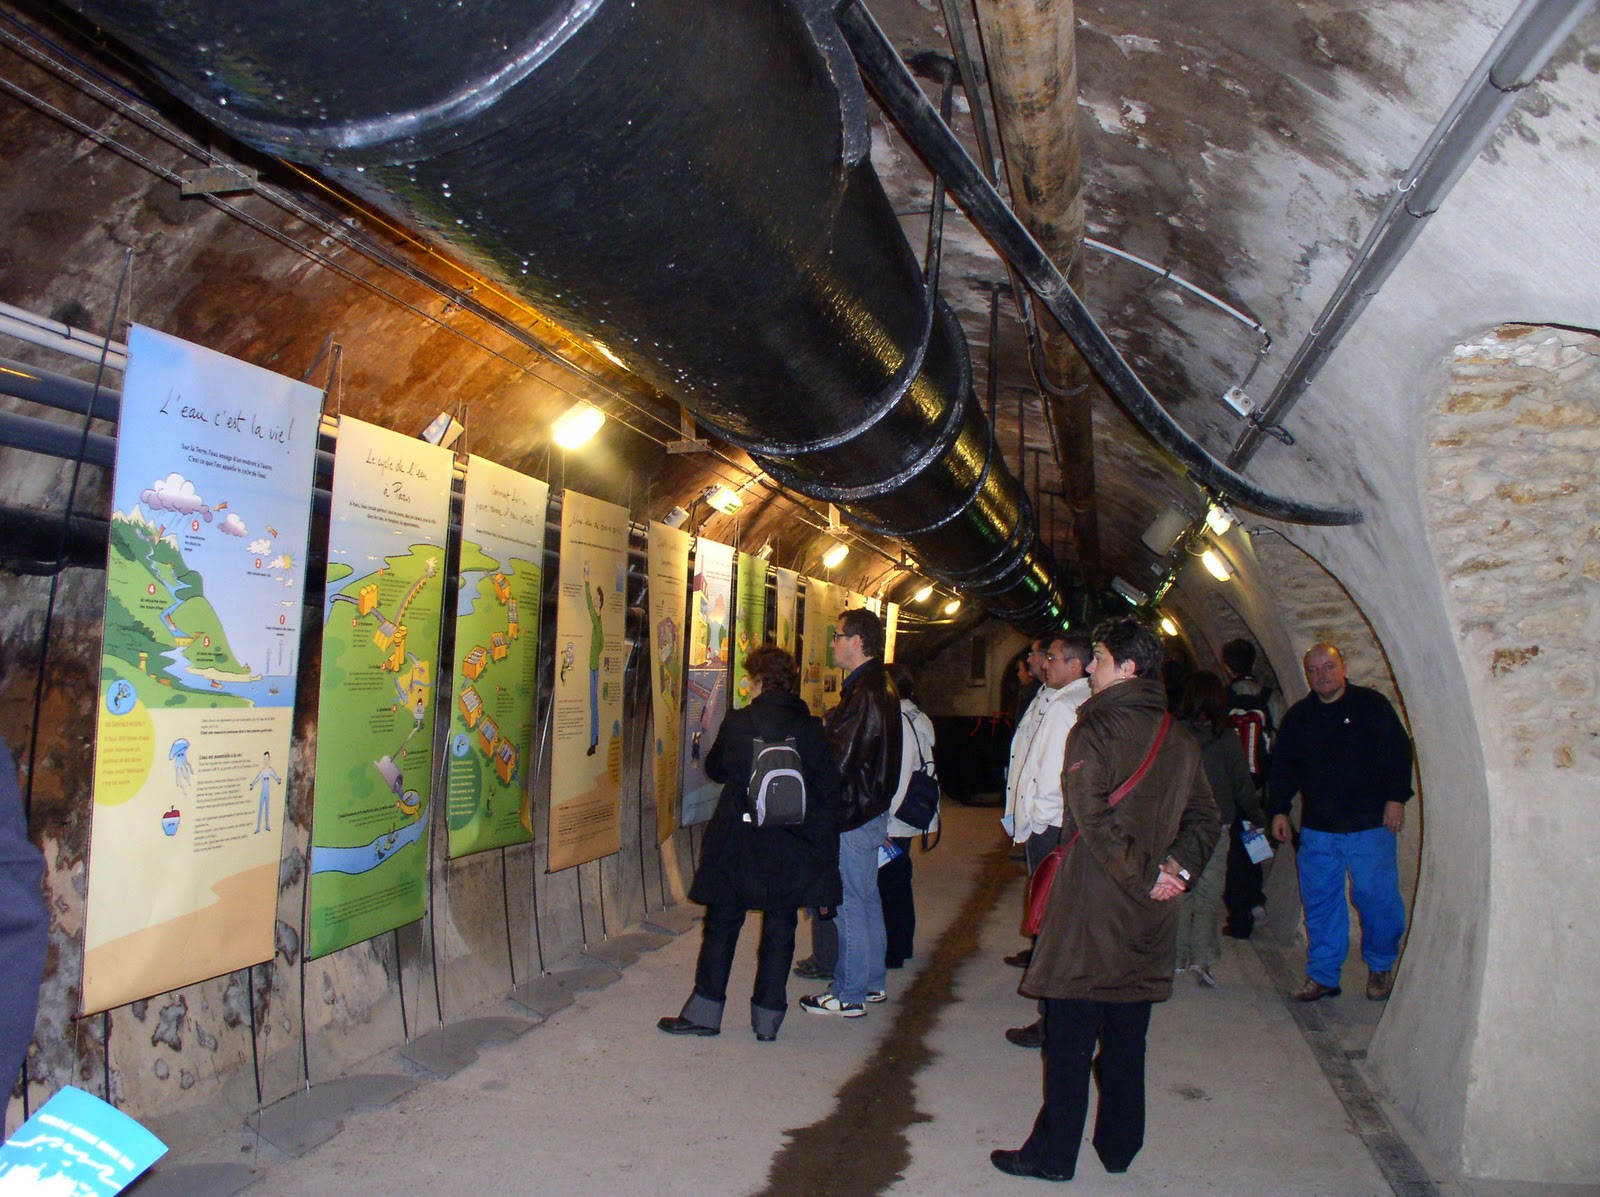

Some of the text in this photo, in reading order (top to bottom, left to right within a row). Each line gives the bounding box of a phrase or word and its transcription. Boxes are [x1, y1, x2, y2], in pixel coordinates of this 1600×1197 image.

[160, 387, 208, 423] L'eau
[214, 409, 246, 433] c'est
[252, 413, 264, 439] la
